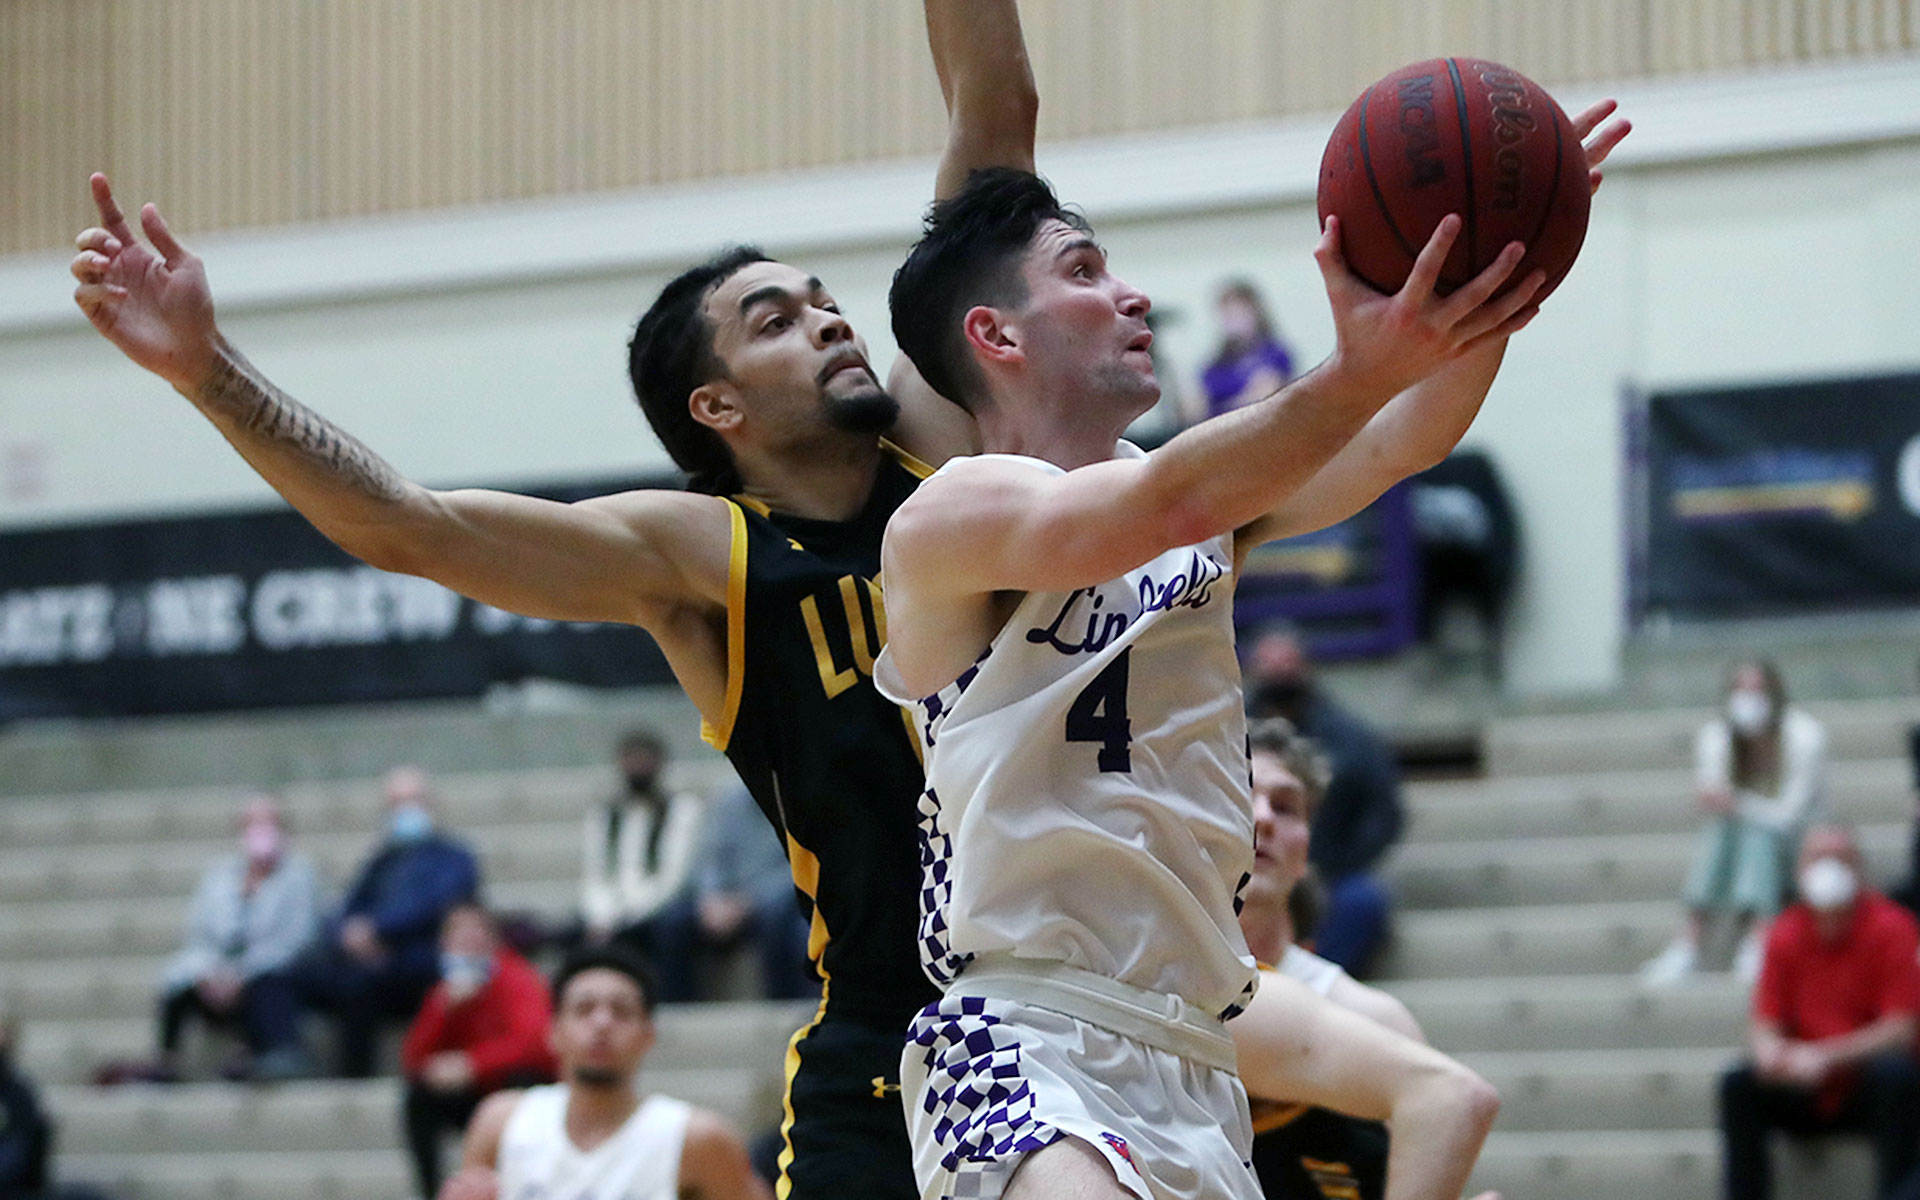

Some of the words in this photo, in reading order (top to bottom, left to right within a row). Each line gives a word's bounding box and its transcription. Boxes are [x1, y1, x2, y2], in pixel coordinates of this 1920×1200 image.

[1397, 75, 1446, 189] NCAA
[1473, 63, 1537, 211] Wilson
[1065, 644, 1134, 773] 4
